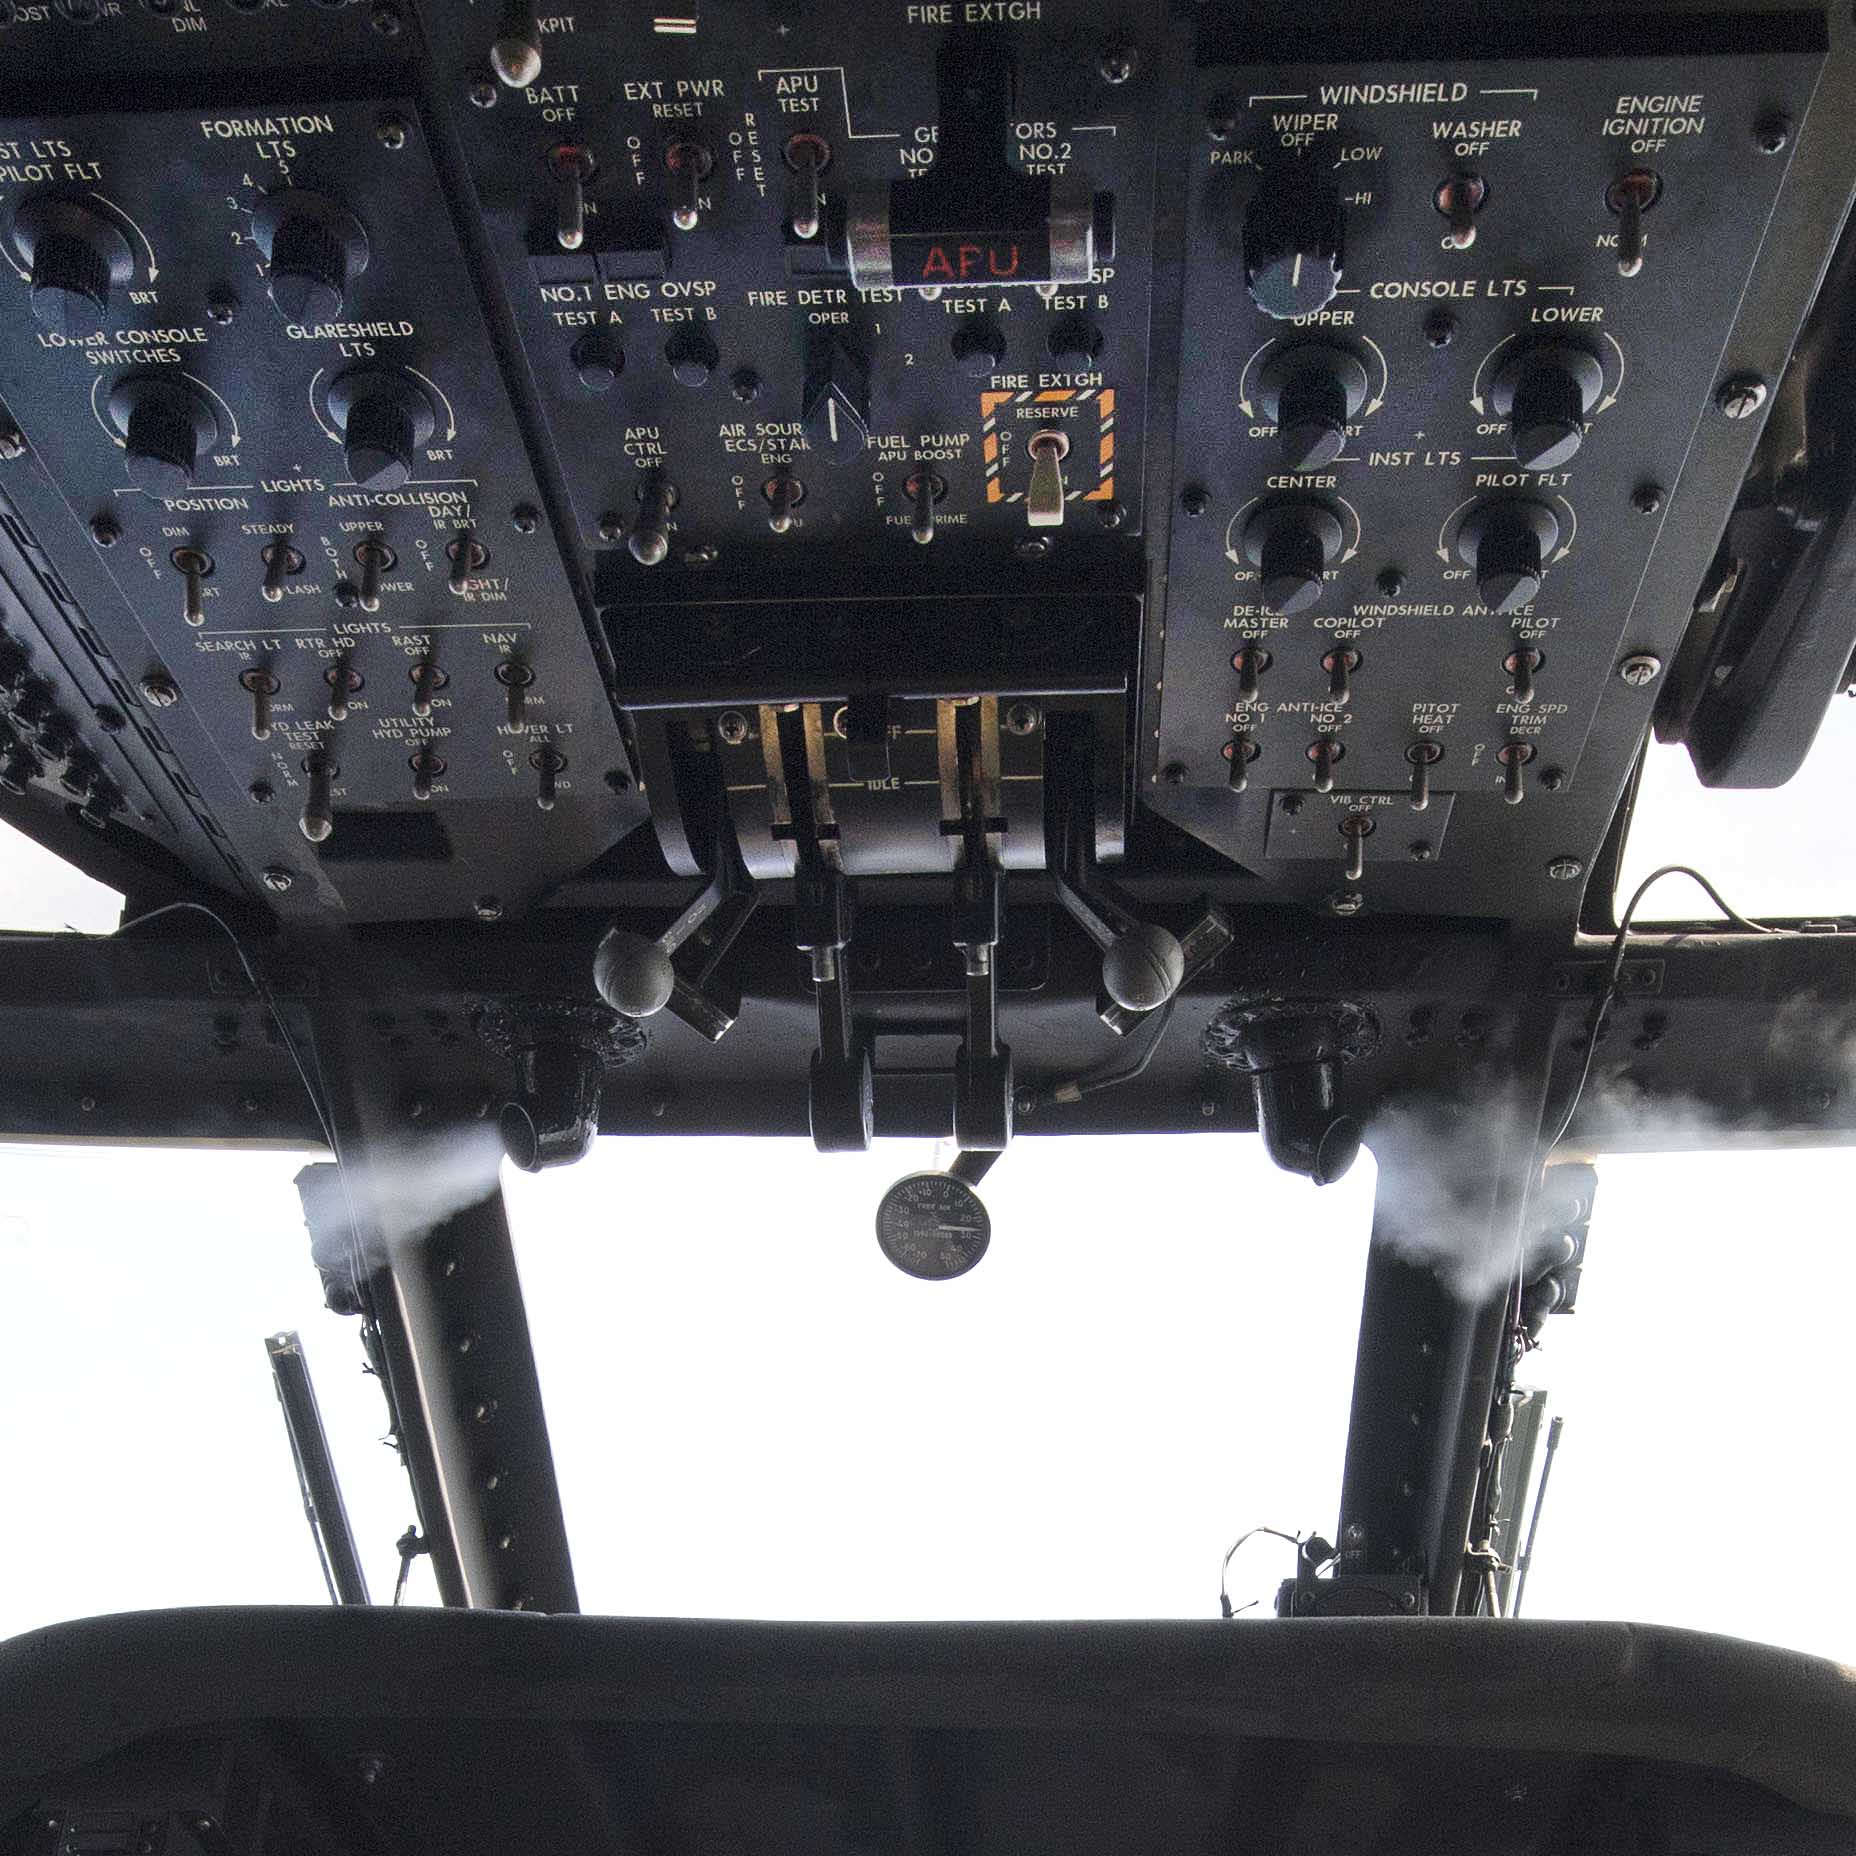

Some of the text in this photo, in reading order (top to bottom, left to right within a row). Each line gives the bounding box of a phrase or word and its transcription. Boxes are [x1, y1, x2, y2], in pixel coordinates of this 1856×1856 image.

[906, 1, 1042, 24] FIRE EXTGH
[171, 16, 208, 32] DIM
[623, 79, 725, 100] EXT PWR
[776, 75, 819, 95] APU
[1320, 82, 1468, 105] WINDSHIELD
[526, 85, 579, 105] BATT
[652, 102, 703, 119] RESET
[778, 97, 820, 113] TEST
[1615, 95, 1703, 115] ENGINE
[543, 108, 576, 122] OFF
[1272, 112, 1338, 132] WIPER
[200, 116, 333, 139] FORMATION
[1431, 119, 1522, 140] WASHER
[1602, 116, 1705, 137] IGNITION
[30, 139, 72, 158] LTS
[256, 139, 296, 158] LTS
[1018, 142, 1072, 161] NO.2
[1340, 146, 1383, 162] LOW
[1209, 150, 1255, 165] PARK
[63, 161, 102, 180] FLT
[922, 244, 1019, 280] APU
[540, 279, 717, 304] NO.1 ENG OVSP
[748, 285, 905, 306] FIRE DETR TEST
[1369, 278, 1526, 299] CONSOLE LTS
[128, 289, 160, 306] BRT
[553, 310, 624, 327] TEST A
[651, 304, 718, 323] TEST B
[808, 310, 850, 326] OPER
[1292, 309, 1355, 328] UPPER
[1530, 305, 1603, 324] LOWER
[115, 325, 208, 345] CONSOLE
[286, 321, 414, 341] GLARESHIELD
[86, 346, 182, 366] SWITCHES
[990, 371, 1103, 389] FIRE EXTGH
[1015, 407, 1079, 421] RESERVE
[624, 428, 660, 442] APU
[720, 424, 750, 439] AIR
[623, 441, 668, 457] CTRL
[866, 432, 970, 451] FUEL PUMP
[878, 448, 962, 462] APU BOOST
[1368, 448, 1462, 468] INST LTS
[261, 478, 325, 494] LIGHTS
[1266, 472, 1336, 489] CENTER
[1475, 470, 1572, 488] PILOT FLT
[164, 498, 248, 512] POSITION
[328, 491, 467, 508] ANTI-COLLISION
[242, 522, 294, 536] STEADY
[1352, 604, 1455, 618] WINDSHIELD
[334, 621, 391, 636] LIGHTS
[1224, 616, 1289, 630] MASTER
[1313, 616, 1386, 630] COPILOT
[1510, 616, 1561, 630] PILOT
[195, 638, 281, 653] SEARCH LT
[296, 637, 355, 650] RTR HD
[392, 634, 432, 647] RAST
[482, 632, 517, 645] NAV
[1235, 702, 1343, 714] ENG ANTI-ICE
[1412, 703, 1460, 715] PITOT
[1496, 703, 1568, 715] ENG SPD
[378, 716, 435, 728] UTILITY
[1412, 714, 1455, 725] HEAT
[373, 725, 452, 740] HYD PUMP
